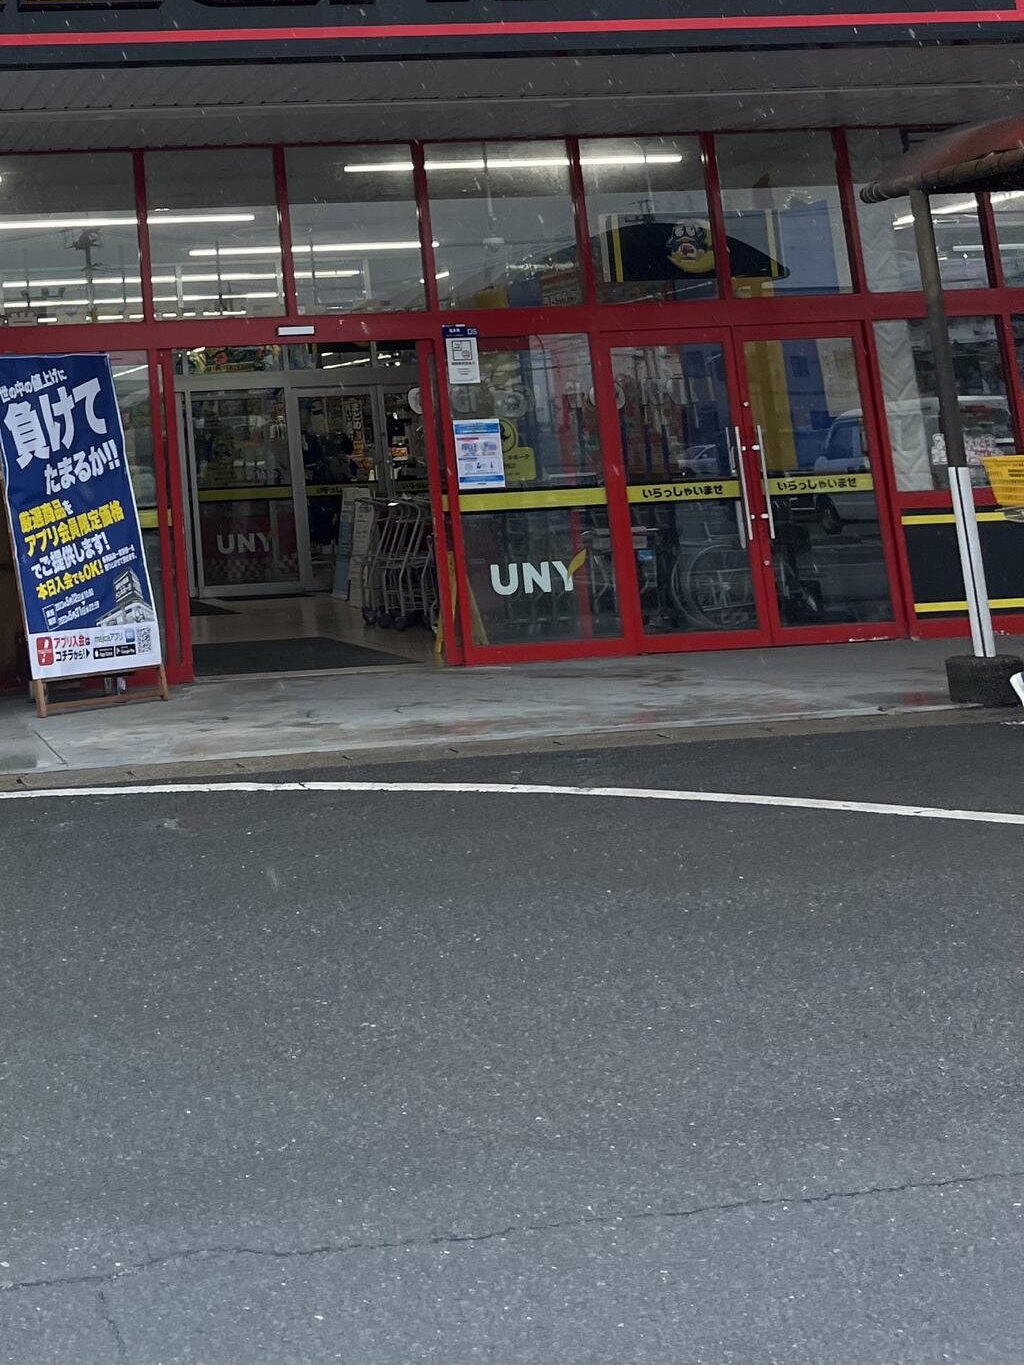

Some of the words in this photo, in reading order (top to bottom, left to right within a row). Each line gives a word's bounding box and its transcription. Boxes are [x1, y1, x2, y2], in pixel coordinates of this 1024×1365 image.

[3, 377, 107, 469] 負けて
[642, 484, 723, 498] いらっしゃいませ
[777, 477, 857, 491] いらっしゃいませ
[24, 500, 125, 557] アプリ会員限定価格
[216, 532, 270, 554] UNY
[490, 560, 574, 595] UNY
[53, 634, 91, 649] アプリ入会は
